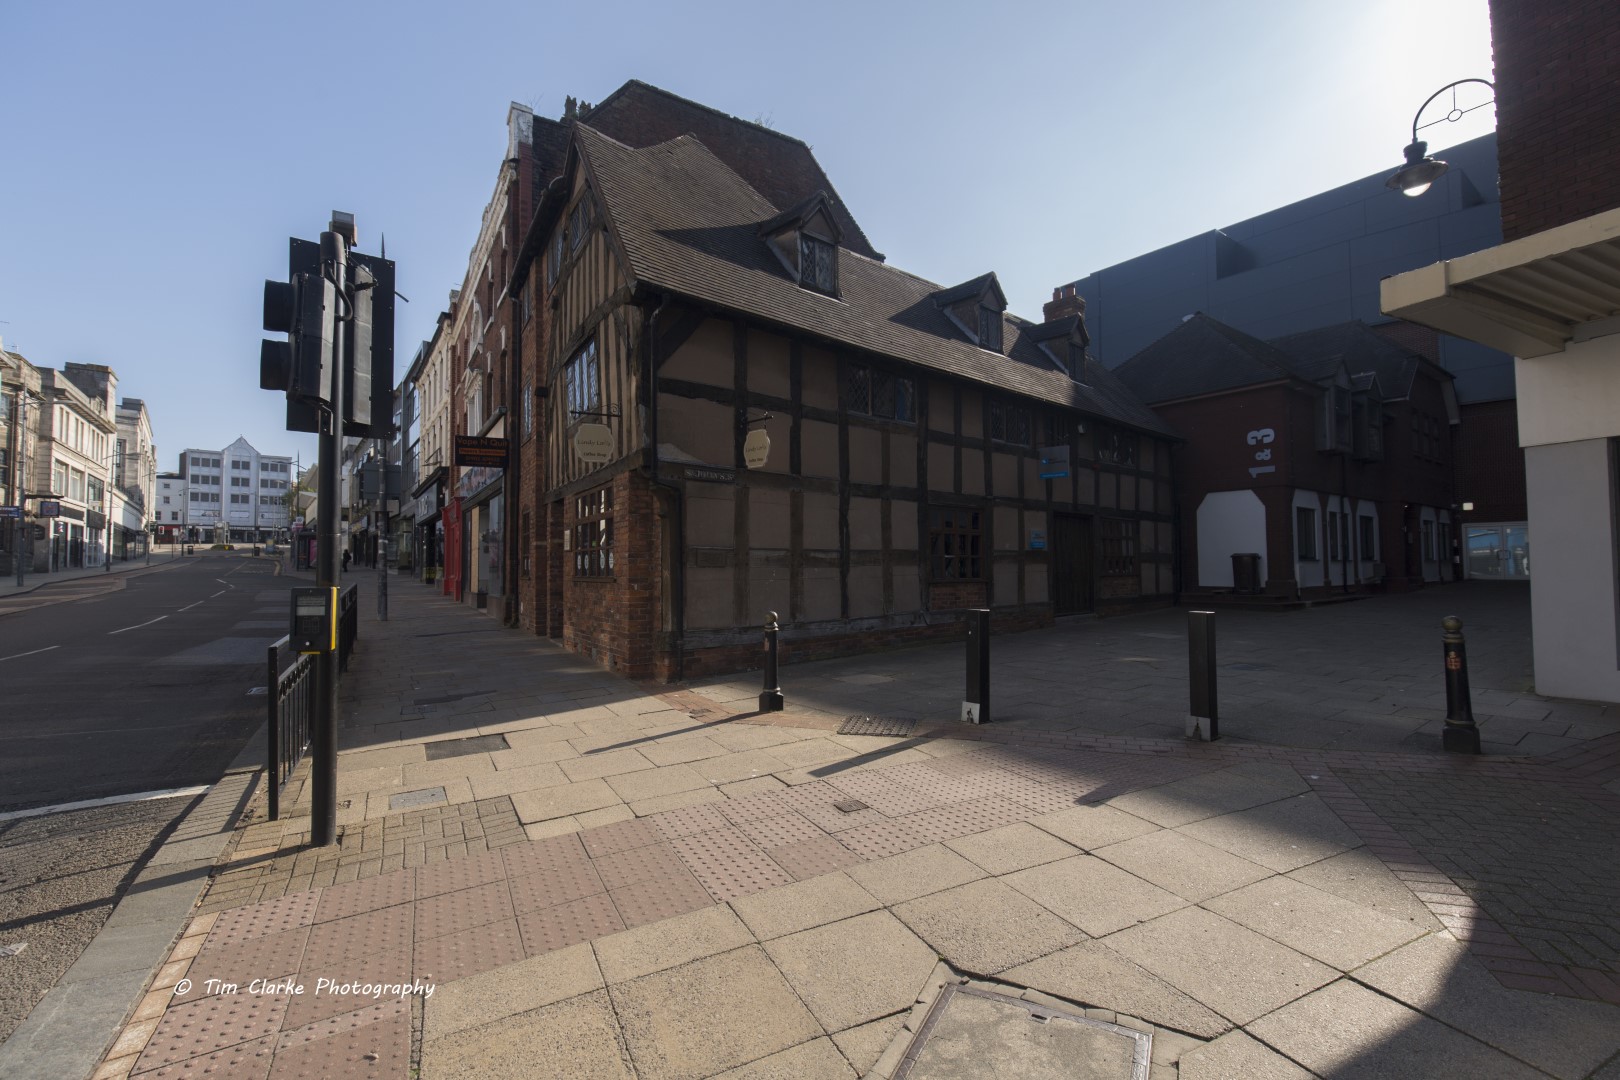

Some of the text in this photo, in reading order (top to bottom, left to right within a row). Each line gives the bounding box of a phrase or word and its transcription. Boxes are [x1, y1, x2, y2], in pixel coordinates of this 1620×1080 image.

[456, 437, 479, 446] Vape
[480, 438, 488, 446] N
[1246, 428, 1275, 446] 3
